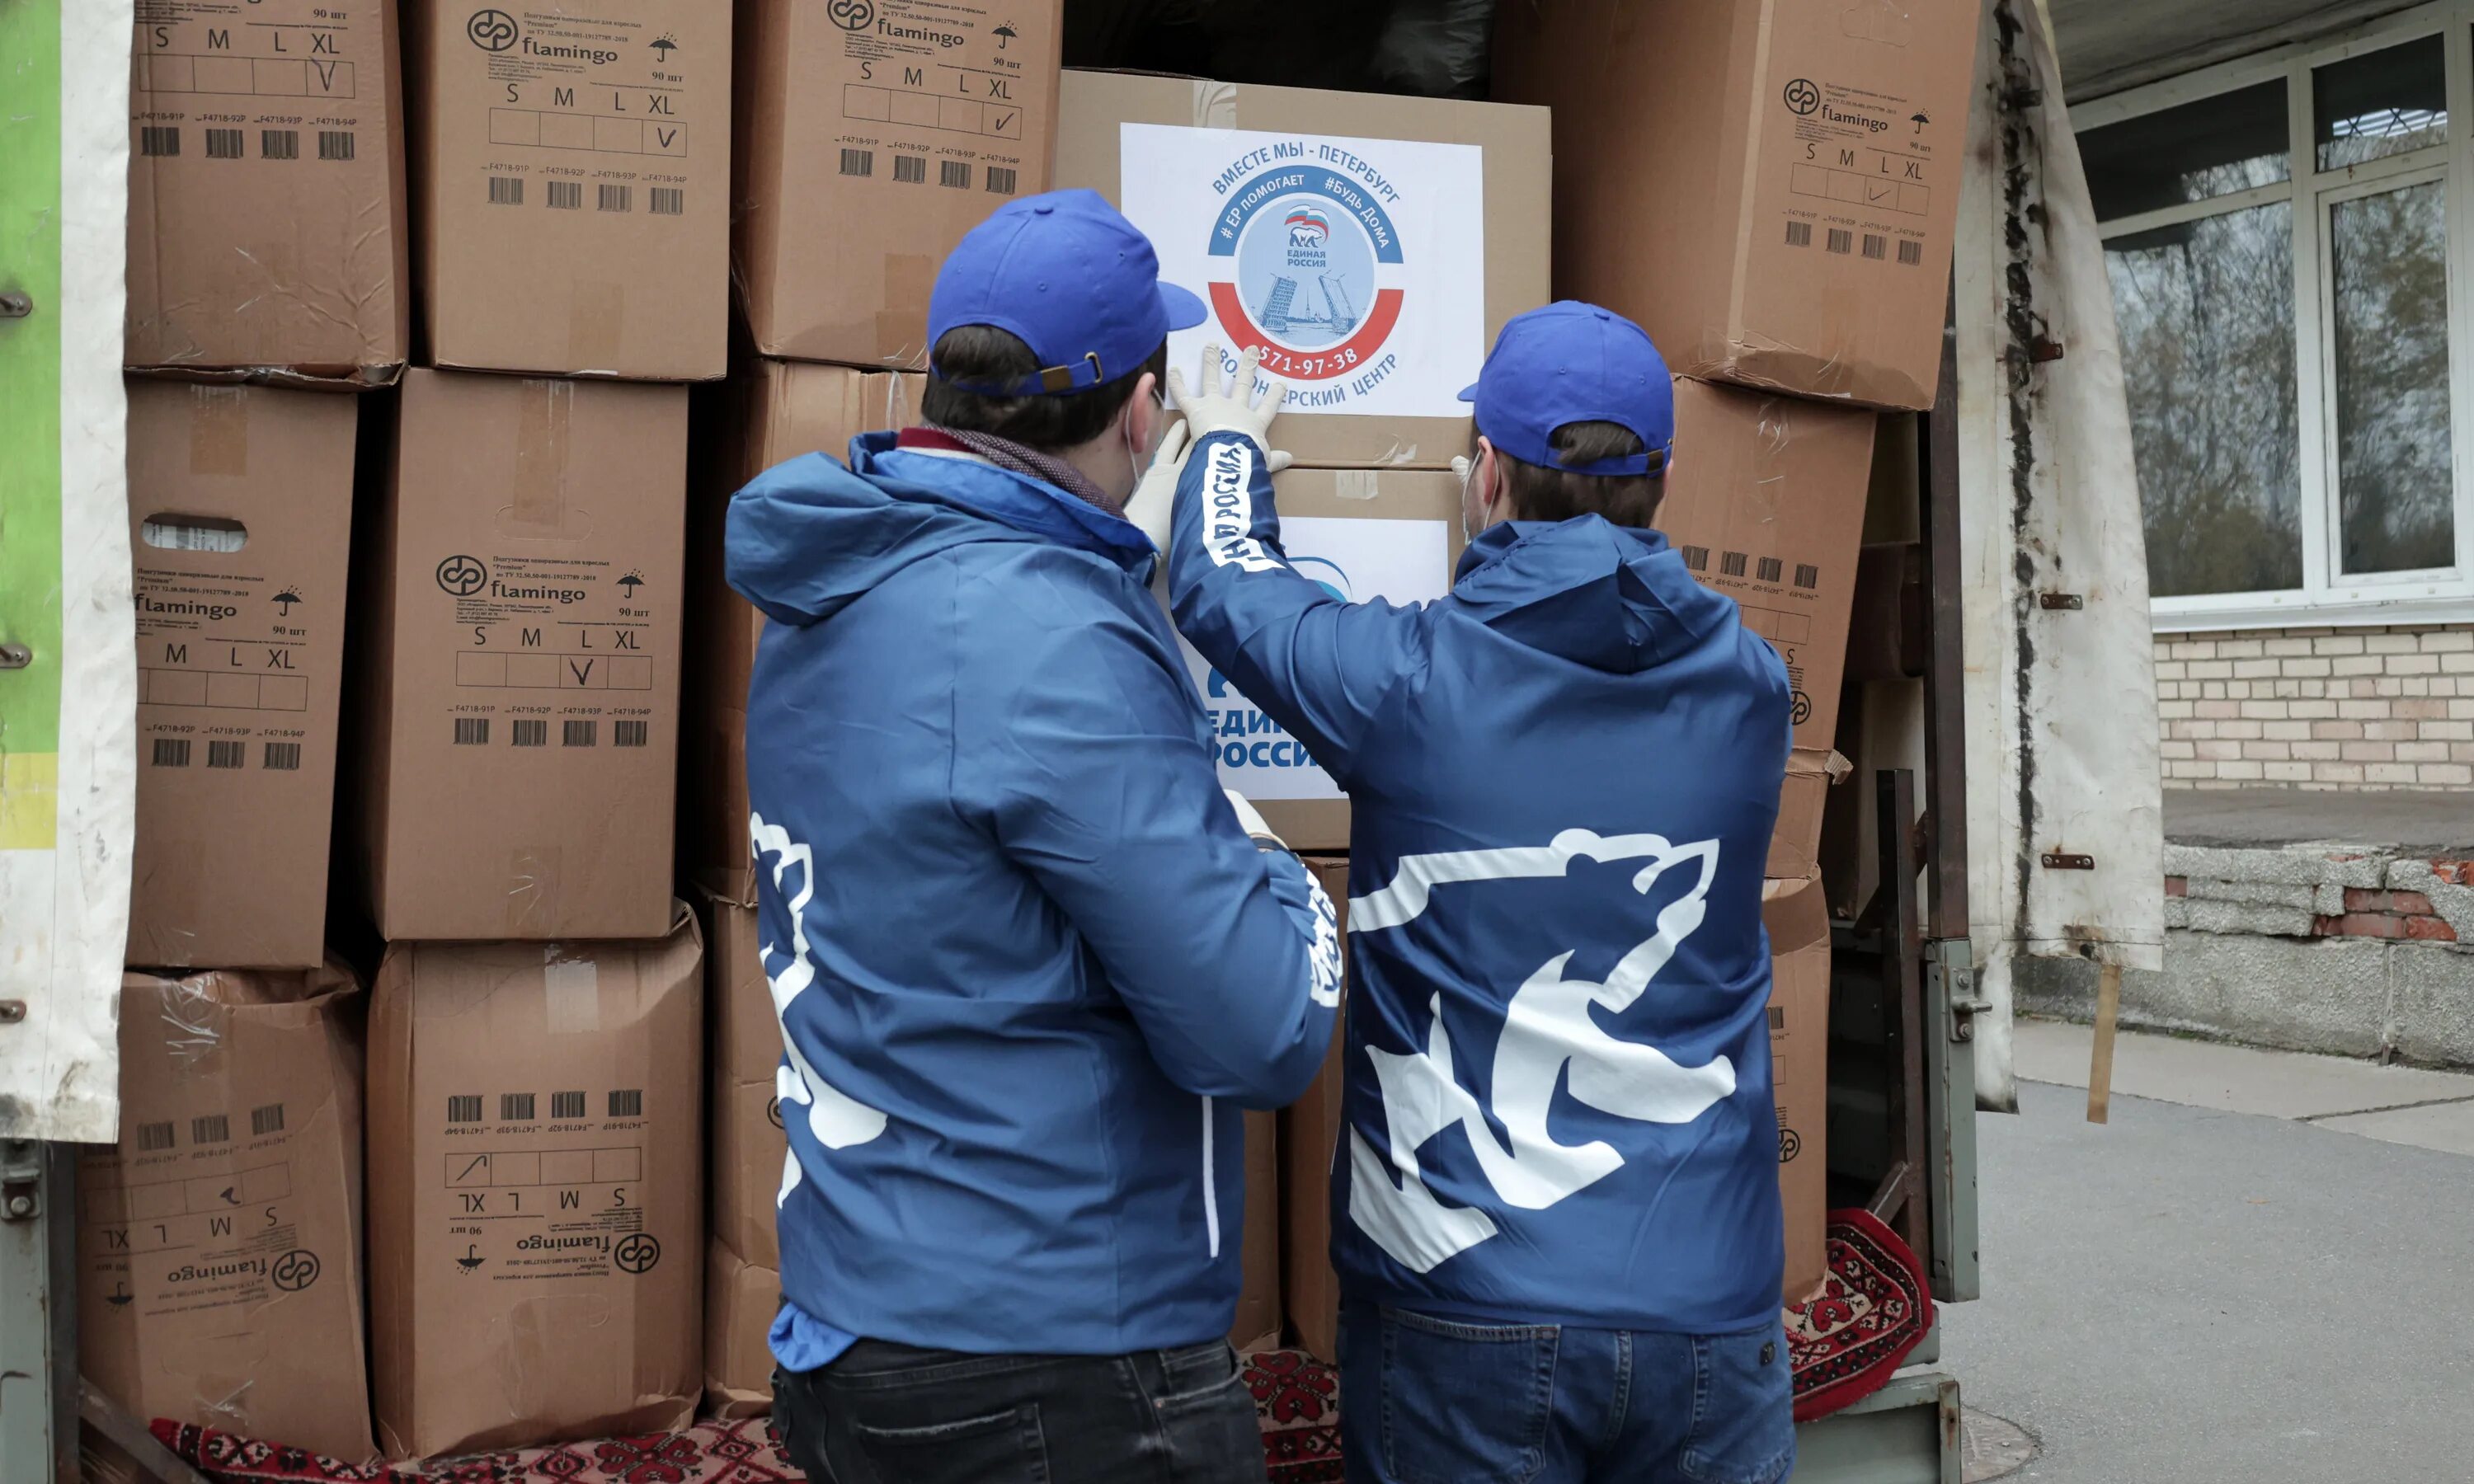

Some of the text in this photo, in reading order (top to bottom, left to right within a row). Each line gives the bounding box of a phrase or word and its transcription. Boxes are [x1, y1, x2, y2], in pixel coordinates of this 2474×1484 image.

[313, 9, 327, 19] 90
[156, 26, 340, 54] S M L XL
[877, 19, 965, 48] flamingo
[522, 37, 618, 64] flamingo
[994, 57, 1022, 70] 90 шт
[651, 72, 665, 81] 90
[861, 62, 872, 80] S
[905, 67, 922, 87] M
[960, 74, 970, 92] L
[989, 78, 1012, 100] XL
[507, 83, 675, 115] S M L XL
[141, 112, 357, 126] F4718-91P F4718-92P F4718-93P F4718-94P
[1822, 104, 1888, 133] flamingo
[842, 136, 1020, 165] F4718-91P F4718-92P F4718-93P F4718-94P
[1807, 143, 1815, 160] S
[1839, 148, 1854, 167] M
[1881, 157, 1889, 173] L
[1904, 161, 1923, 180] XL
[489, 162, 687, 183] F4718-91P F4718-92P F4718-93P F4718-94P
[1212, 148, 1271, 195] ВМЕСТЕ
[1273, 142, 1304, 159] МЫ
[1319, 144, 1400, 204] ПЕТЕРБУРГ
[1225, 209, 1241, 227] ЕР
[1240, 174, 1305, 211] ПОМОГАЕТ
[1324, 176, 1363, 209] #БУДЬ
[1360, 205, 1390, 248] ДОМА
[1287, 249, 1326, 259] ЕДИНАЯ
[1287, 258, 1326, 268] РОССИЯ
[1259, 346, 1358, 376] 571-97-38
[1352, 353, 1396, 396] ЦЕНТР
[491, 580, 586, 604] flamingo
[134, 593, 237, 621] flamingo
[618, 608, 650, 618] 90 шт
[272, 626, 308, 636] 90 шт
[474, 626, 641, 650] S M L XL
[166, 643, 296, 669] M L XL
[1786, 648, 1794, 665] S
[455, 705, 651, 716] F4718-91P F4718-92P F4718-93P F4718-94P
[153, 724, 305, 738] F4718-92P F4718-93P F4718-94P
[444, 1122, 642, 1136] F4718-91P F4718-92P F4718-93P F4718-94P
[458, 1188, 625, 1213] S M L XL
[101, 1206, 276, 1249] S M L XL
[516, 1235, 611, 1252] flamingo
[168, 1258, 267, 1283] flamingo
